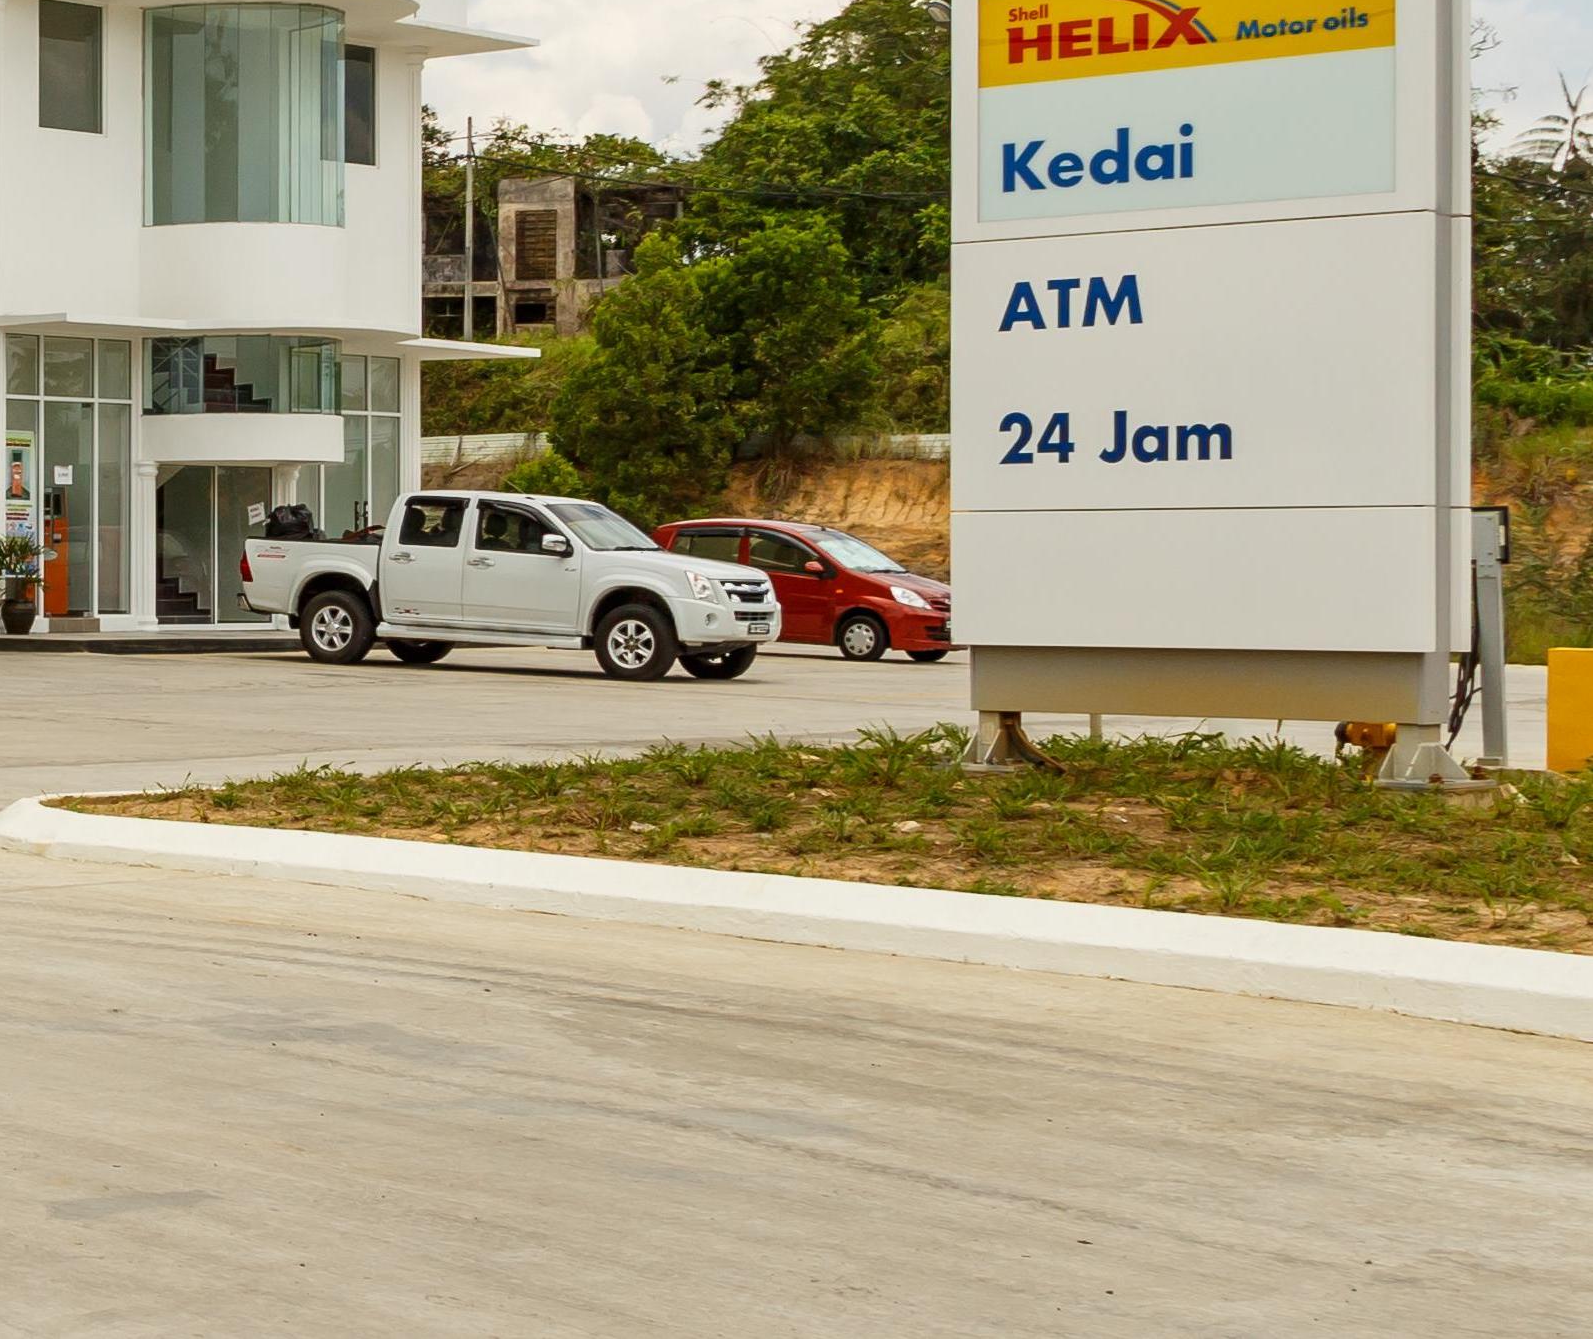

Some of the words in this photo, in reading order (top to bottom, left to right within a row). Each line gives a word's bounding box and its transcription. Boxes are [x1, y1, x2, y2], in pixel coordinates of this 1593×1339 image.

[1008, 4, 1049, 23] Shell
[1236, 18, 1316, 41] Motor
[1321, 7, 1369, 32] oils
[1002, 123, 1194, 193] Kedai
[998, 274, 1144, 332] ATM
[999, 412, 1075, 465] 24
[1099, 410, 1233, 465] Jam
